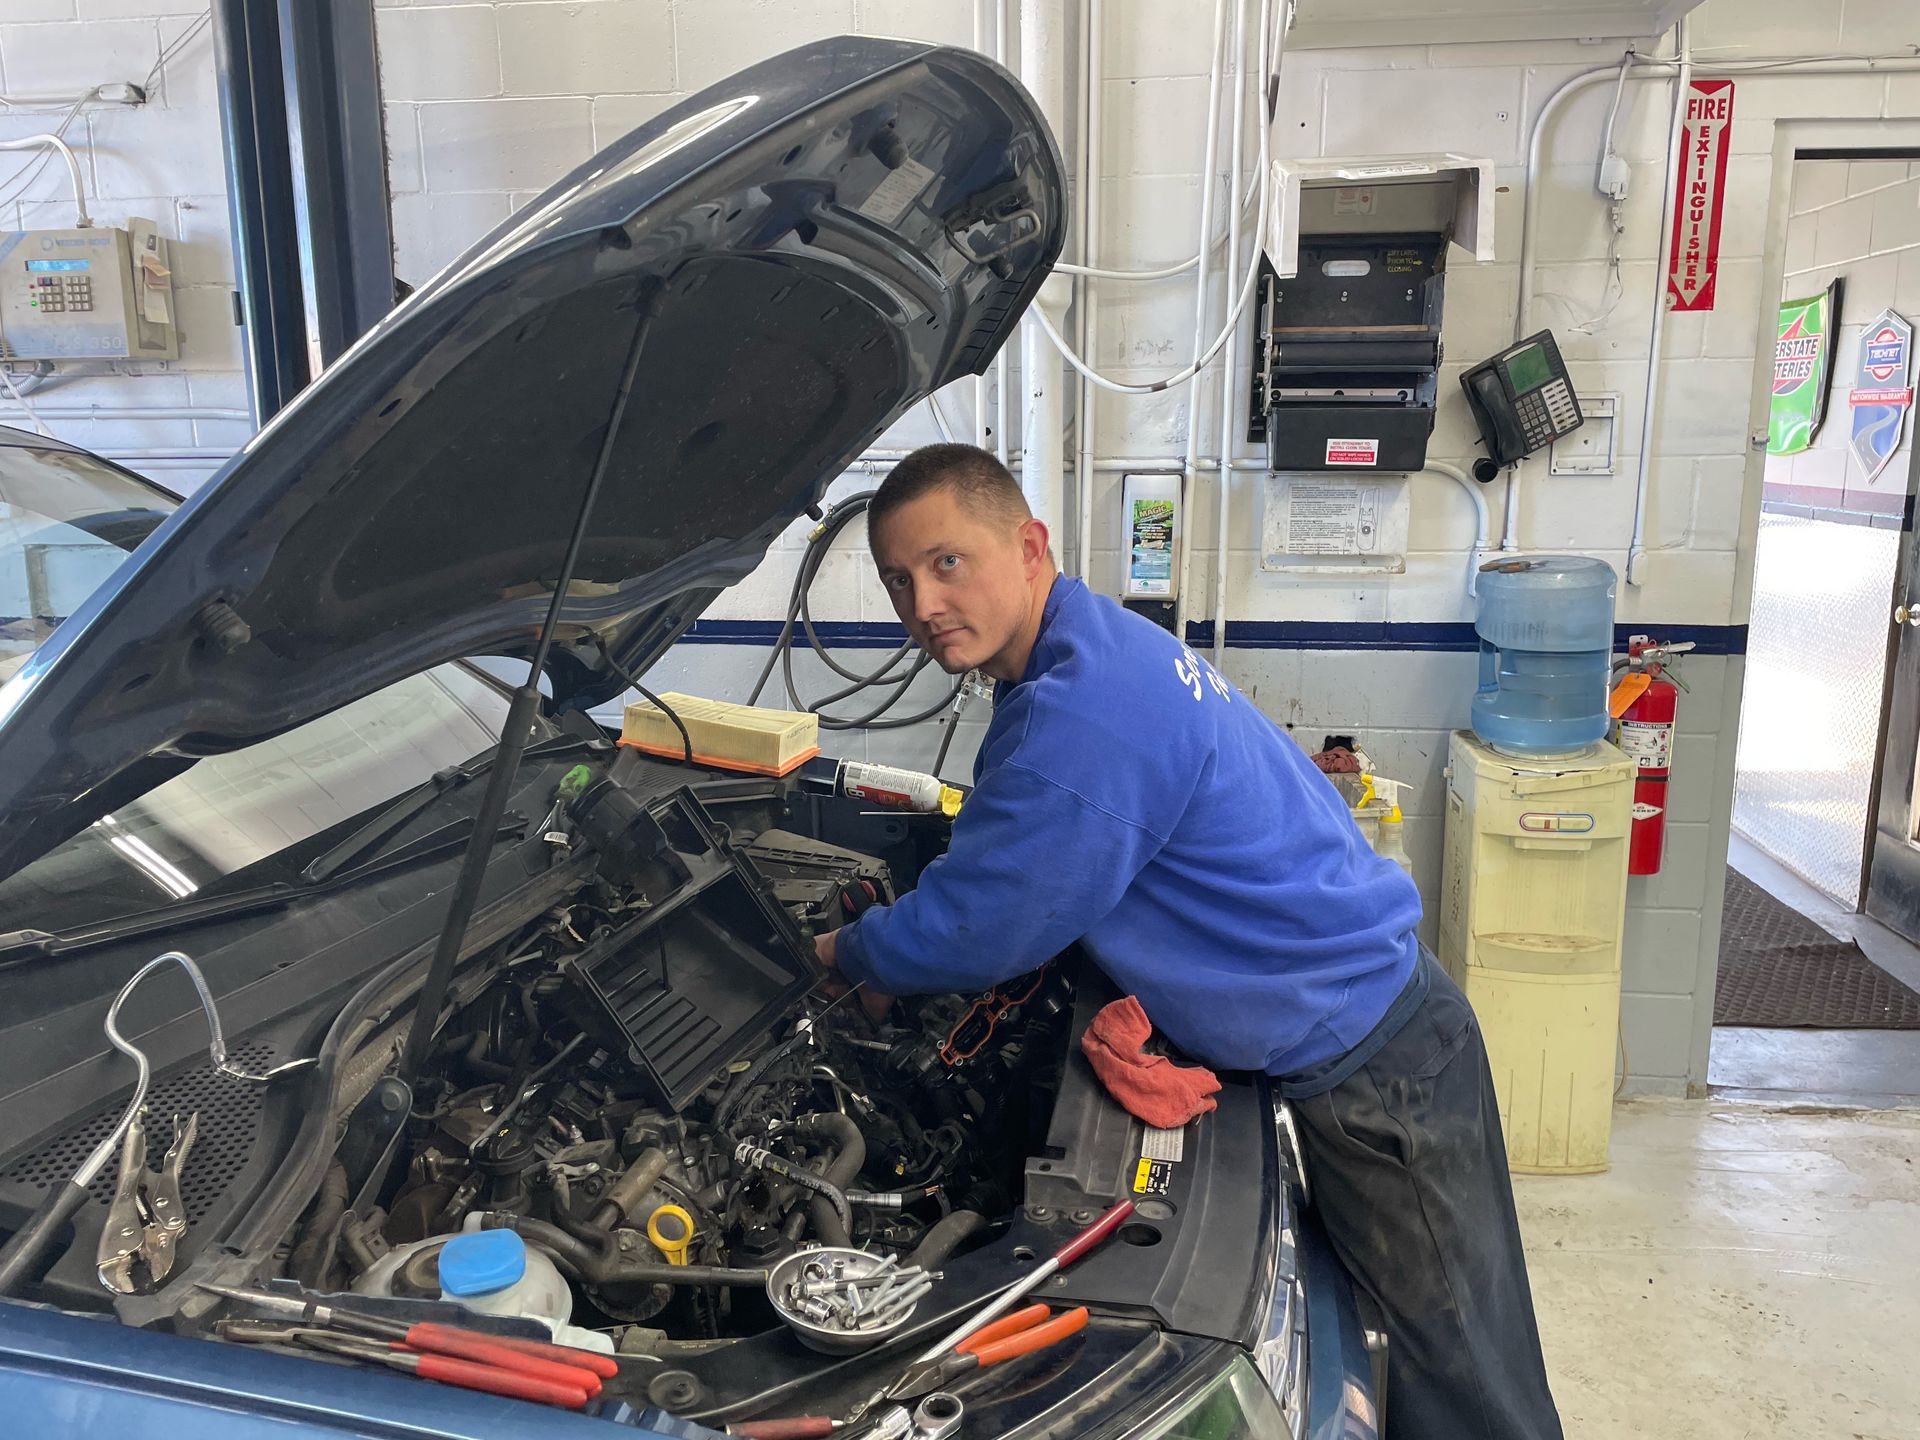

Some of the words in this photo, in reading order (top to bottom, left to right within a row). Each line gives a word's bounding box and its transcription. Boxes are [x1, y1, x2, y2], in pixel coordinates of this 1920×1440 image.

[1688, 98, 1727, 120] FIRE
[1684, 125, 1710, 290] EXTINGUISHER
[1775, 361, 1811, 378] TERIES
[1139, 505, 1168, 518] MAGIC
